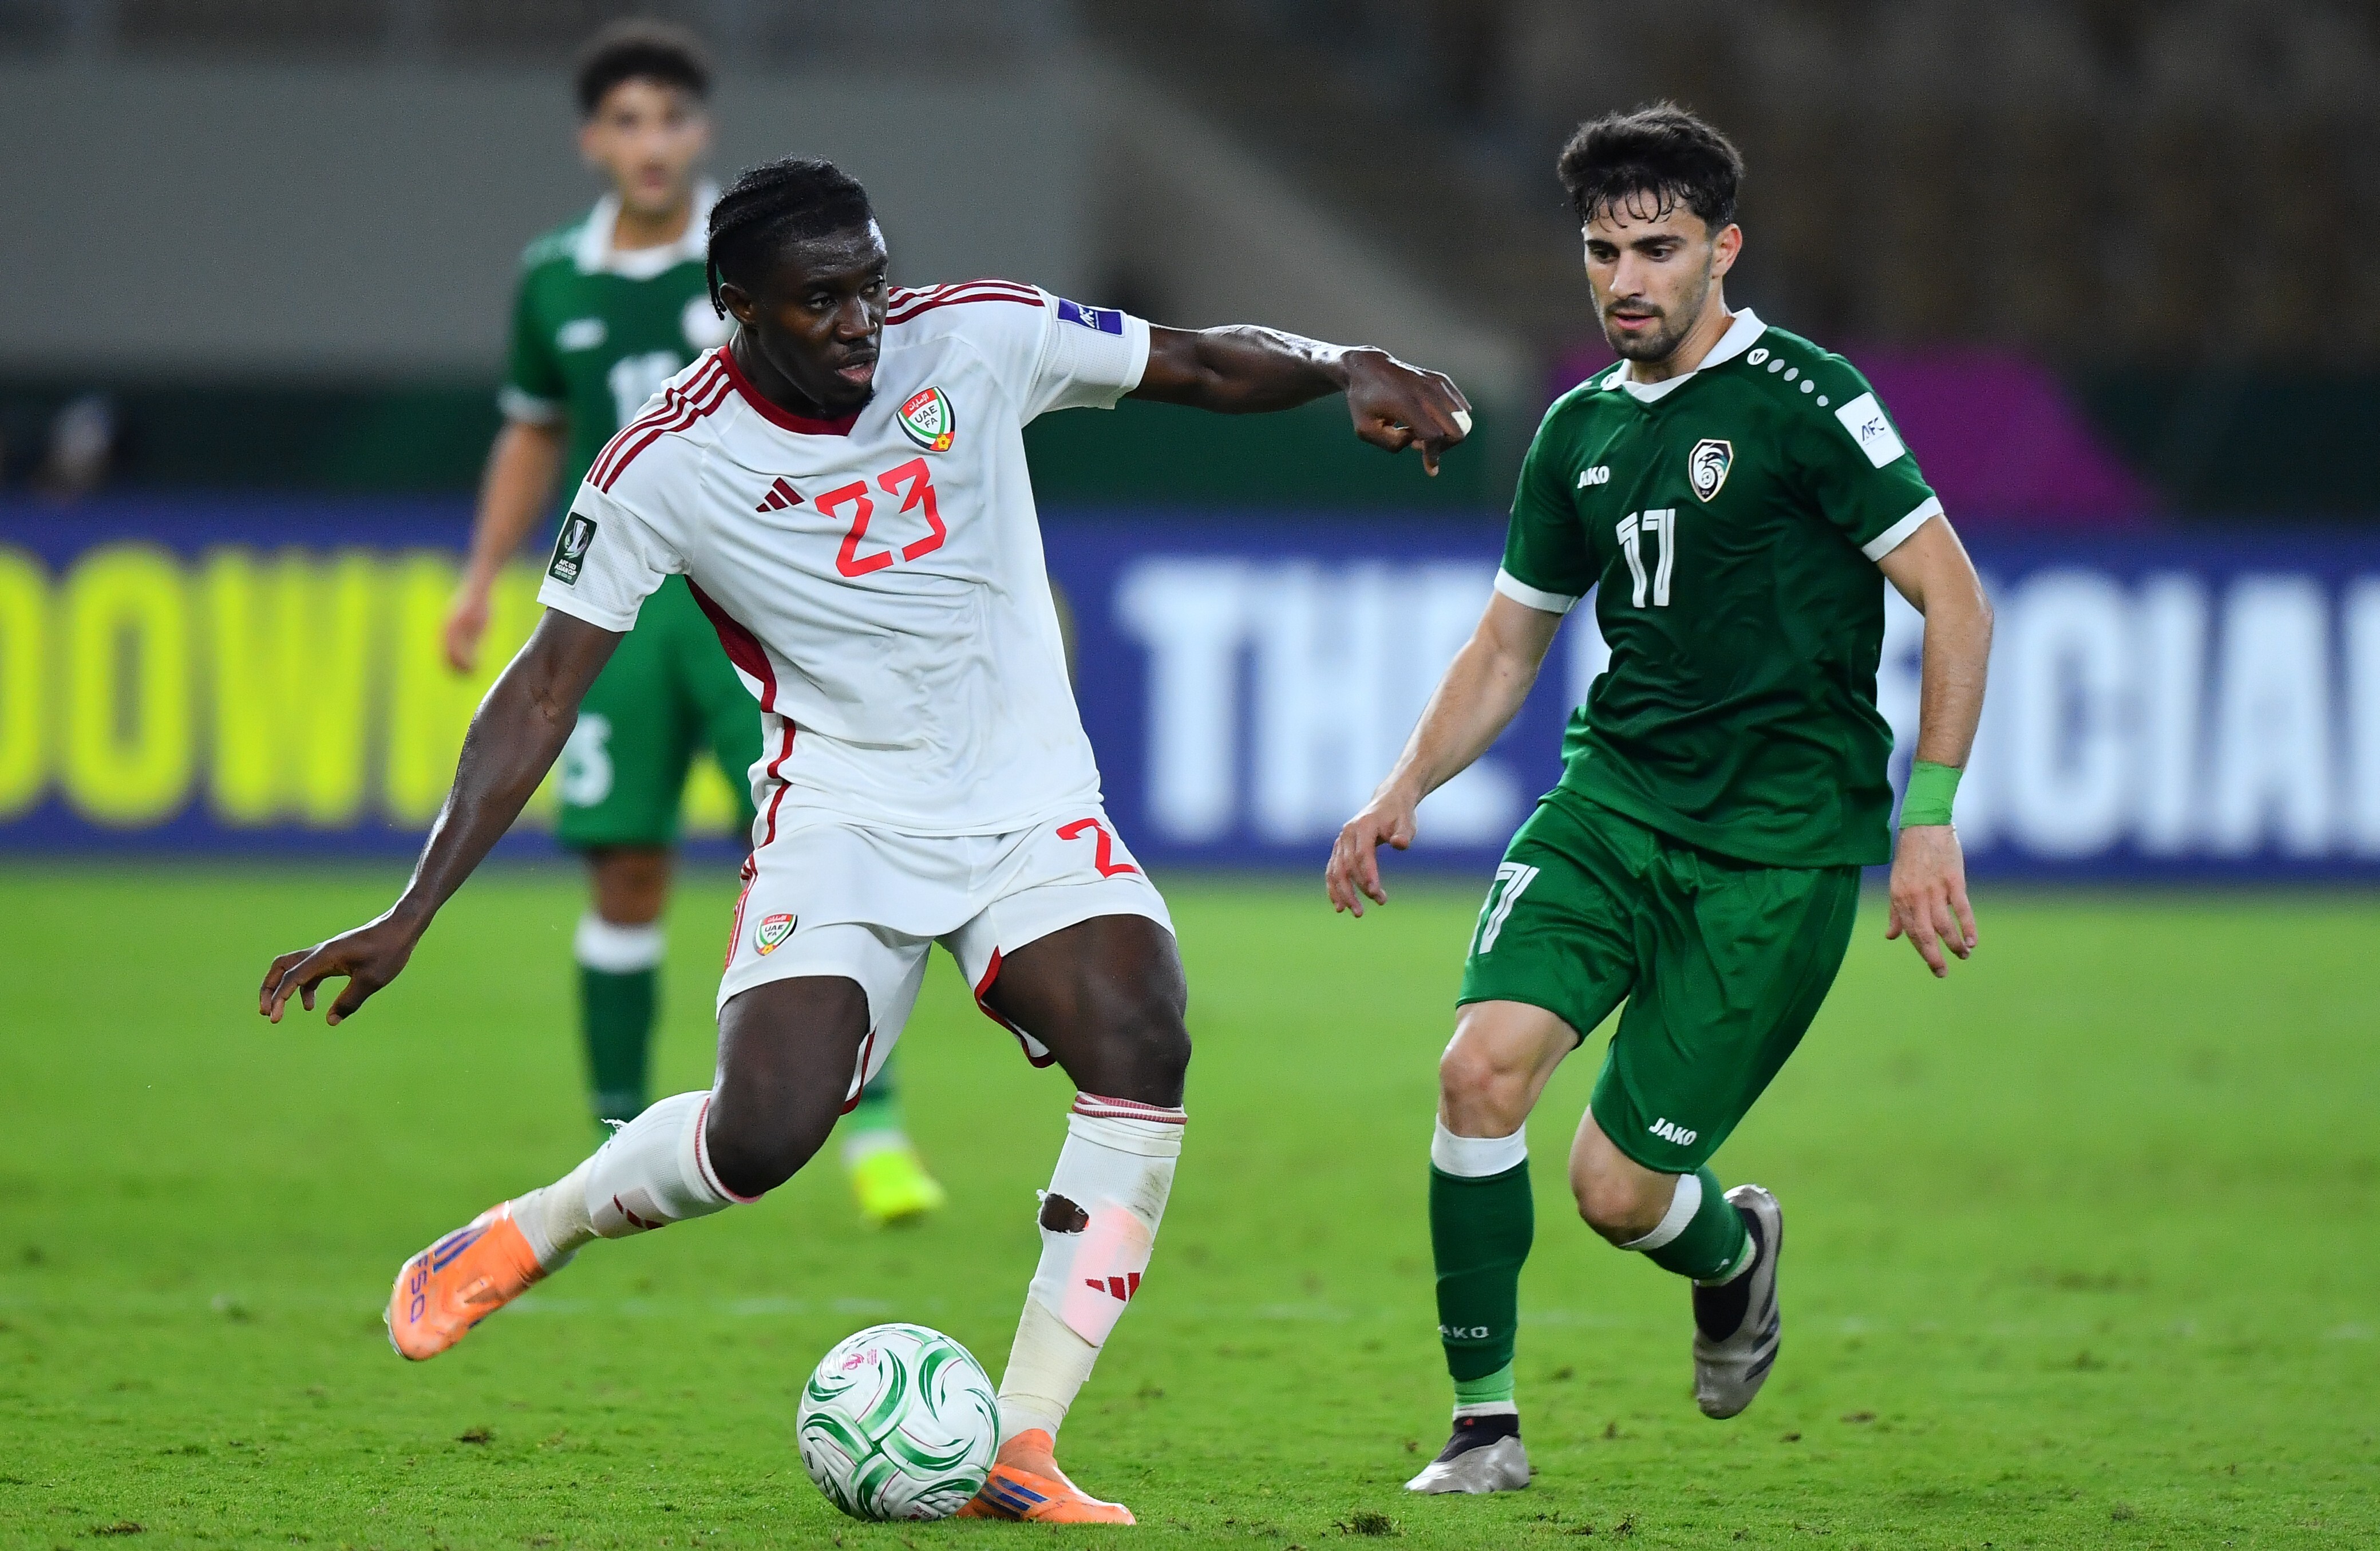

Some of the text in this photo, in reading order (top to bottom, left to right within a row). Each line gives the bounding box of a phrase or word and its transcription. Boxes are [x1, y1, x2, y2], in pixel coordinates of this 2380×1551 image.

[914, 405, 938, 423] UAE
[924, 417, 938, 428] FA
[1861, 416, 1885, 442] AFC
[1577, 465, 1610, 489] JAKO
[814, 457, 947, 577] 23
[1615, 508, 1677, 609] 17
[765, 924, 784, 932] UAE
[1648, 1118, 1697, 1146] JAKO
[1438, 1324, 1489, 1339] AKO
